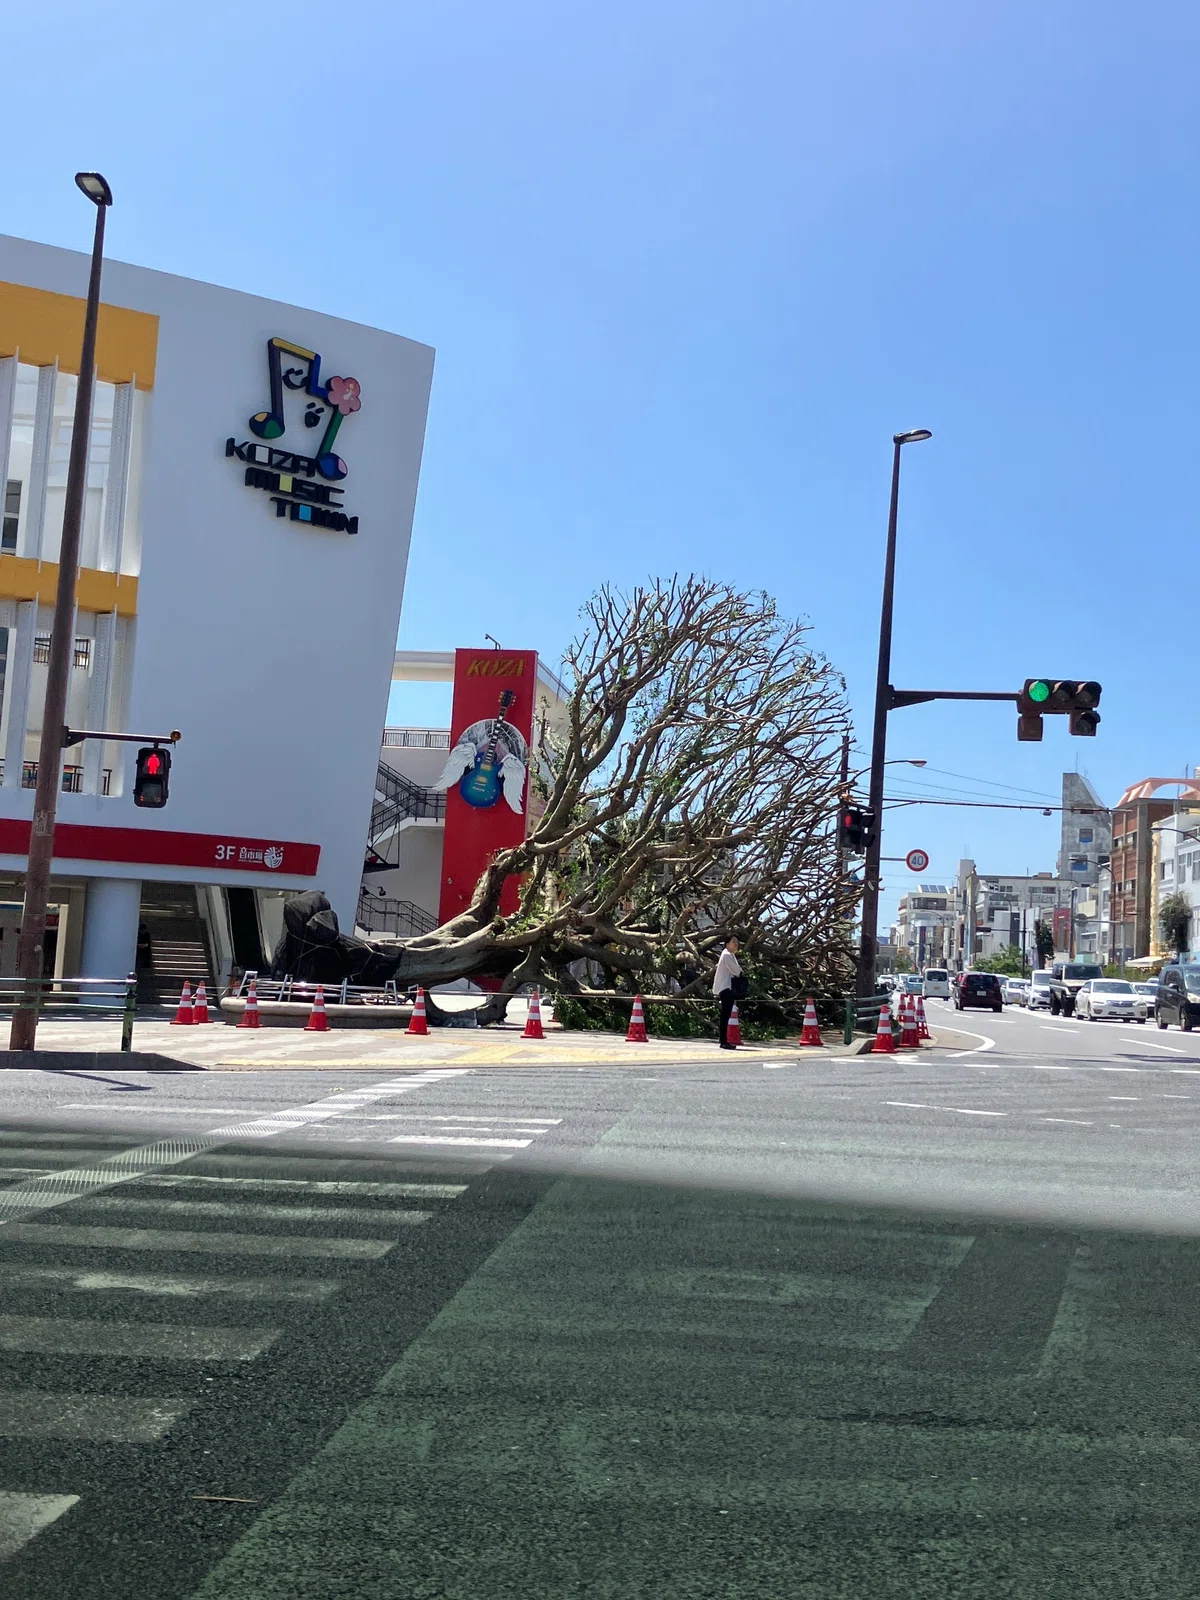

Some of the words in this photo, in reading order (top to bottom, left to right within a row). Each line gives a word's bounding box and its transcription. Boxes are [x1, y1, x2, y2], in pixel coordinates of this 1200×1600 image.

[225, 437, 316, 477] KOZA
[245, 467, 345, 508] MUSIC
[269, 496, 359, 534] TOWN
[466, 658, 525, 677] KOZA
[214, 844, 236, 860] 3F
[911, 855, 924, 866] 40
